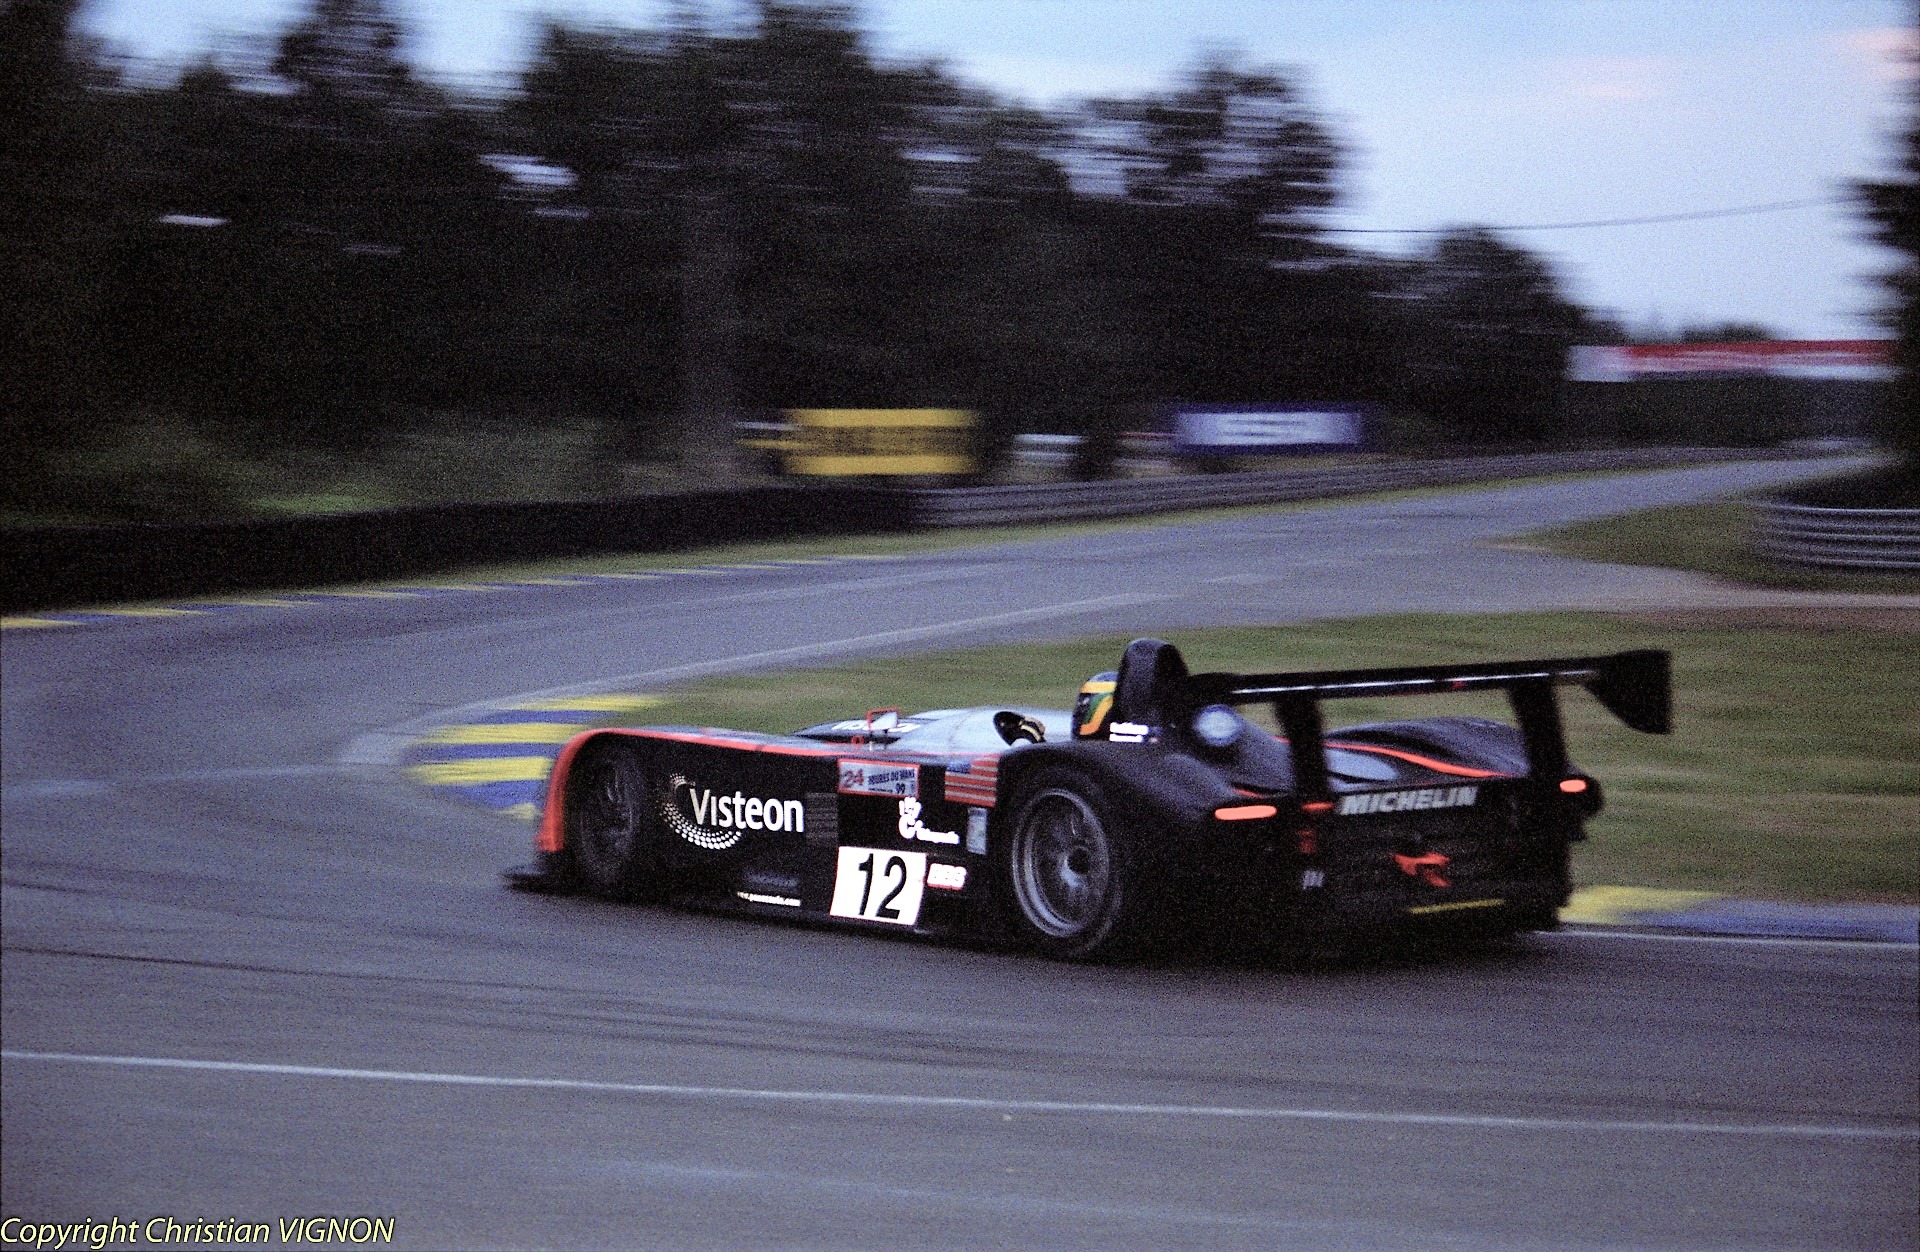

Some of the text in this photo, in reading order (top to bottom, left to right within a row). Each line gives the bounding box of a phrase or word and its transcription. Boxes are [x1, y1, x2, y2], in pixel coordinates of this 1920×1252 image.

[843, 768, 864, 788] 24
[689, 787, 805, 833] Visteon
[1339, 786, 1478, 816] MICHELIN
[858, 853, 906, 920] 12
